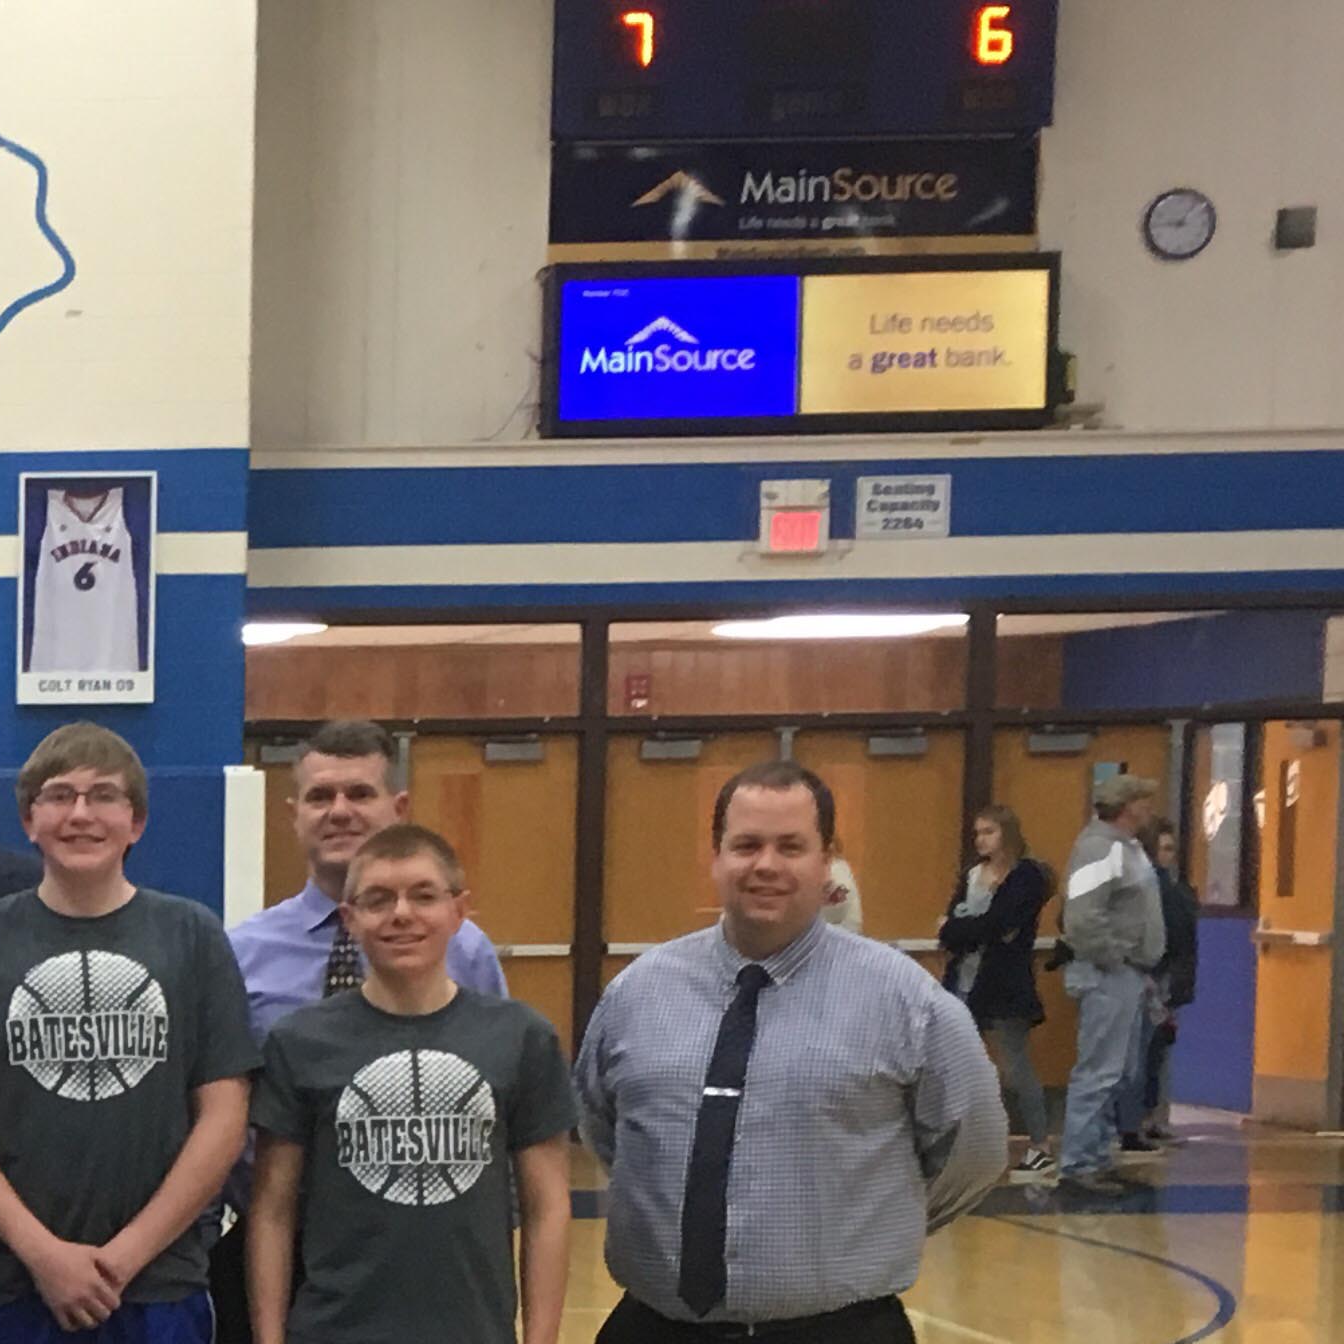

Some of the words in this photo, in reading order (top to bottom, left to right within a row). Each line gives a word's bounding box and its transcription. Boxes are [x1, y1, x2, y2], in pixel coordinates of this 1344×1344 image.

[622, 12, 654, 67] 7
[976, 5, 1013, 64] 6
[740, 167, 958, 204] MainSource
[869, 314, 912, 335] Life
[920, 310, 995, 333] needs
[579, 344, 756, 374] MainSource
[848, 353, 862, 371] a
[871, 348, 938, 374] great
[51, 539, 121, 563] INDIANA
[74, 561, 97, 591] 6
[38, 680, 73, 692] COLT
[78, 680, 111, 692] RYAN
[116, 679, 135, 691] 09
[6, 1011, 168, 1066] BATESVILLE
[335, 1114, 496, 1167] BATESVILLE
